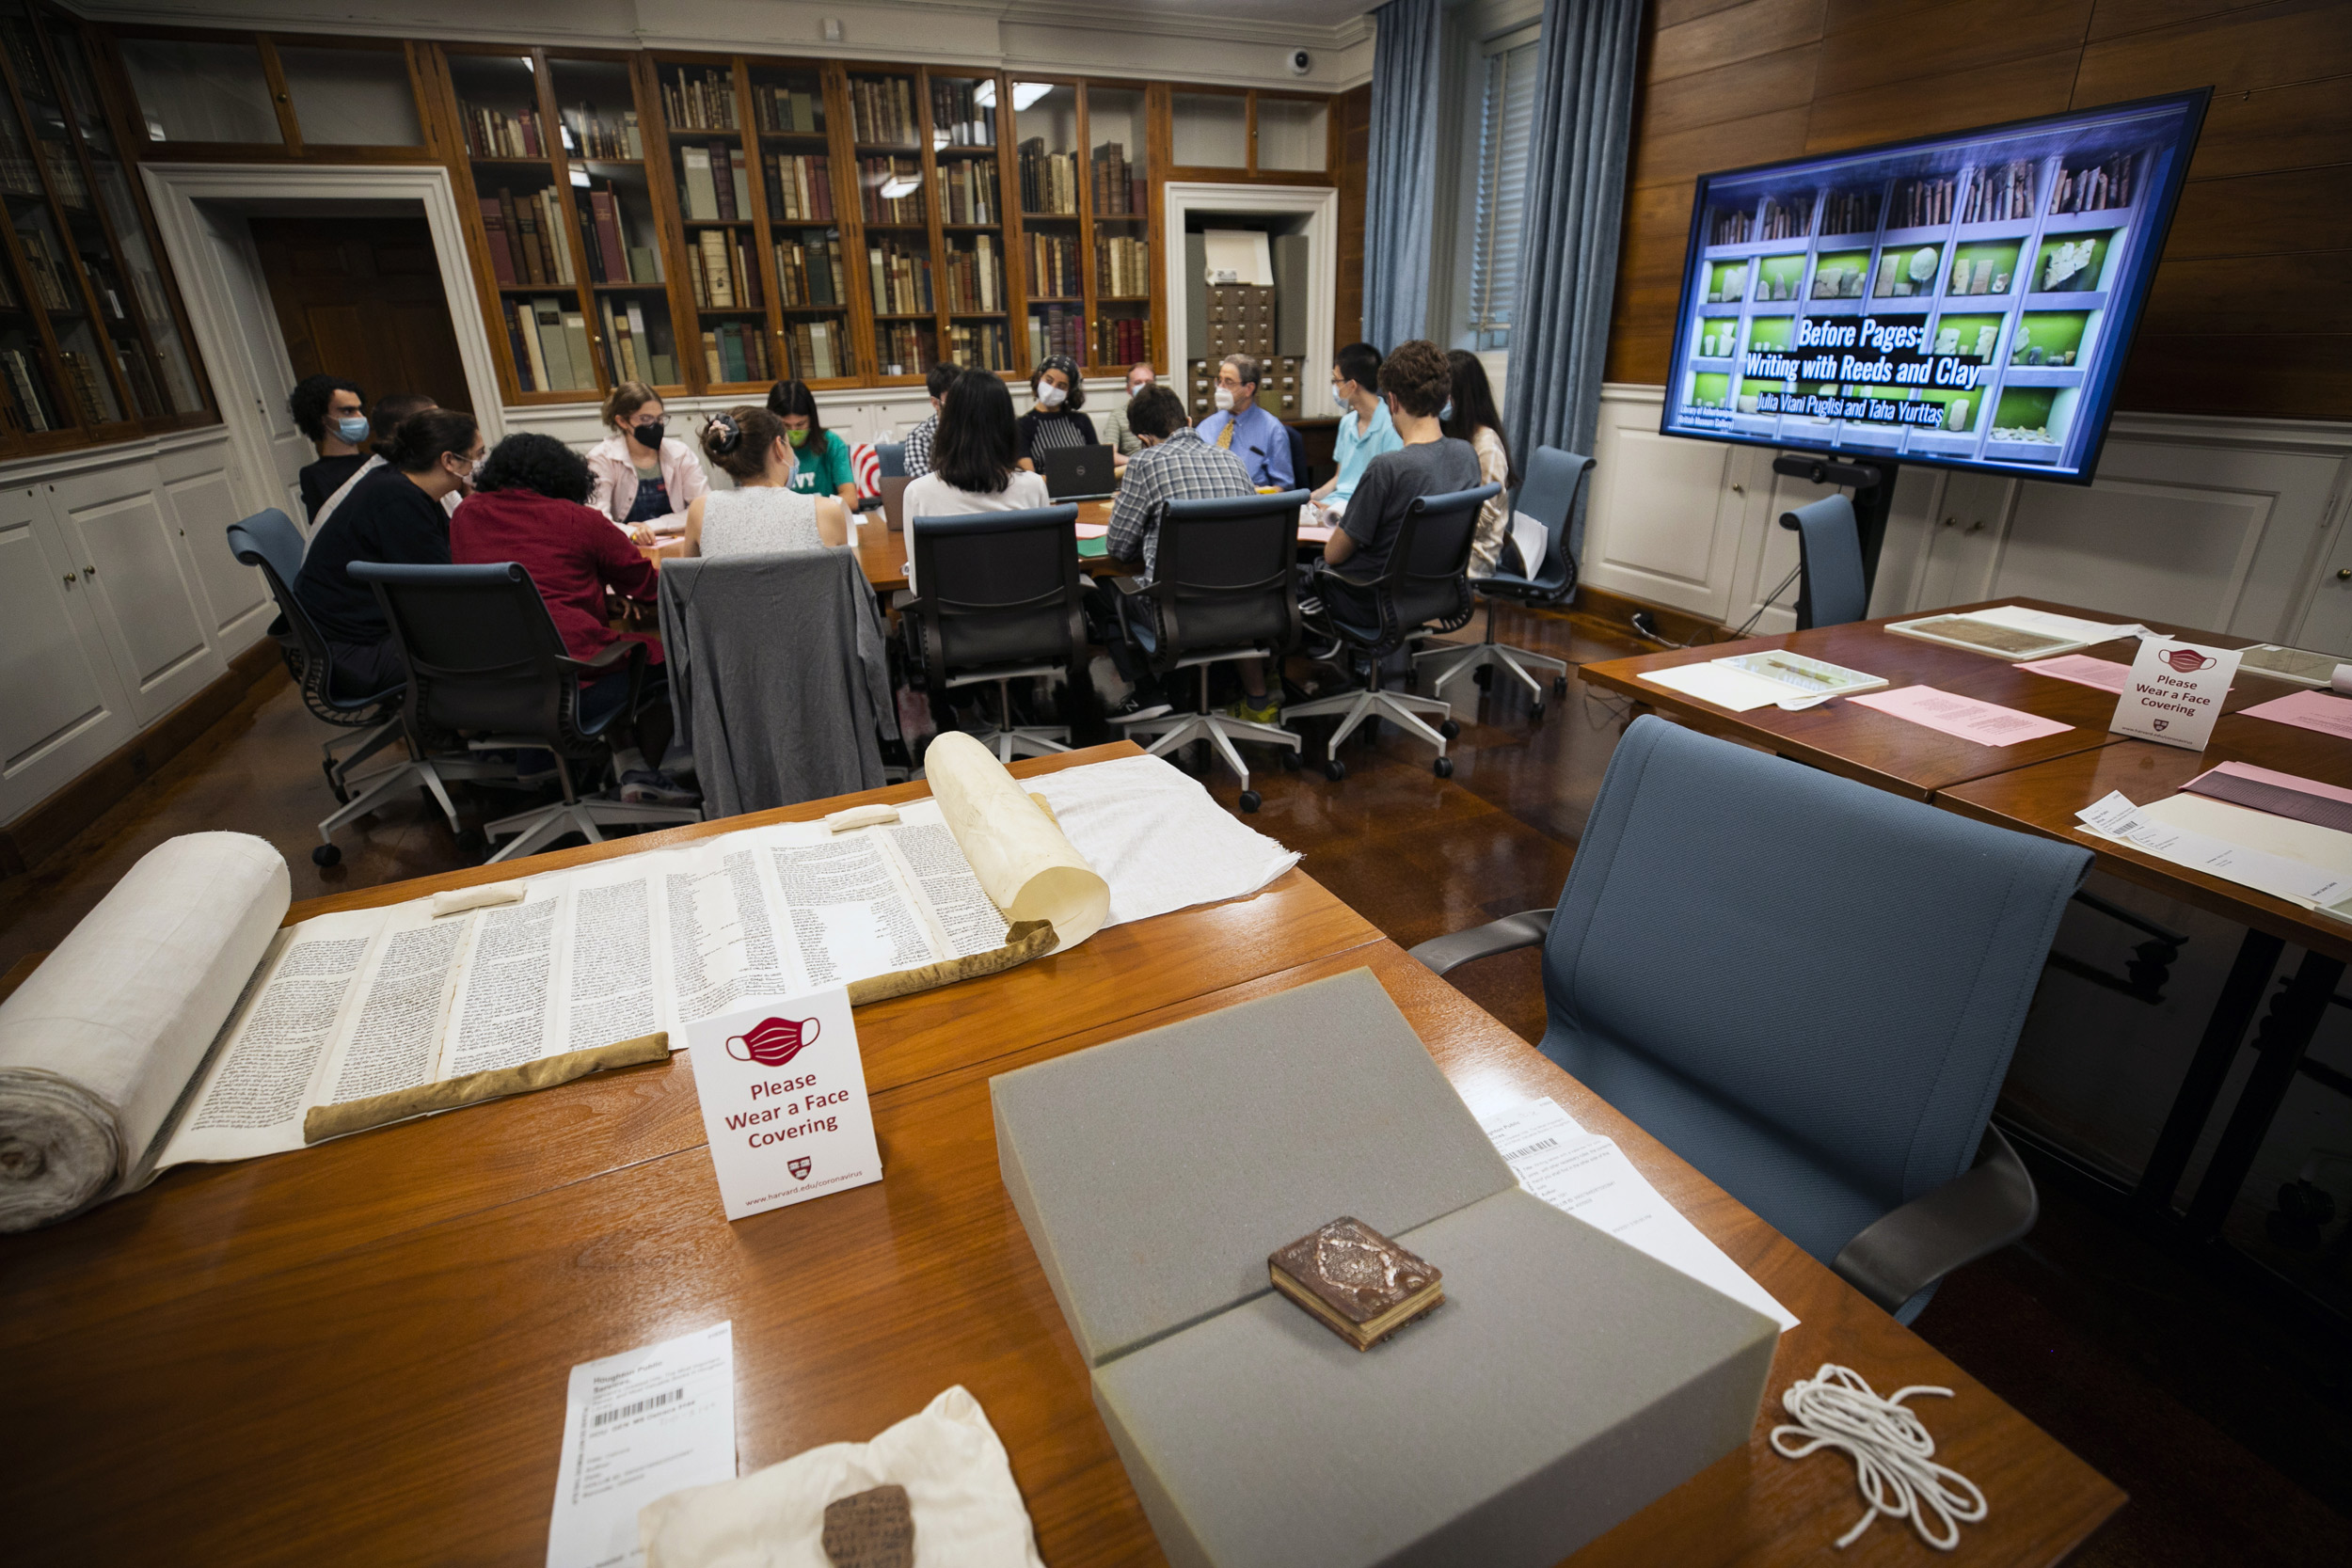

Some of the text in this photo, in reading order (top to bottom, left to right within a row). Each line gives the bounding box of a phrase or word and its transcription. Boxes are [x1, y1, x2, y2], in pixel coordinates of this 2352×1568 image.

[1798, 318, 1925, 354] Before Pages:
[1745, 352, 1982, 390] Writing with Reeds and Clay
[1756, 392, 1779, 412] Julia
[1780, 393, 1806, 414] Viani
[1805, 395, 1845, 418] Puglisi
[1845, 398, 1866, 419] and
[1867, 400, 1896, 421] Taha
[2136, 683, 2169, 697] Wear
[2182, 692, 2211, 705] Face
[2156, 674, 2198, 690] Please
[2141, 697, 2196, 718] Covering
[750, 1073, 817, 1101] Please
[724, 1089, 850, 1132] Wear a Face
[748, 1116, 838, 1148] Covering
[745, 1169, 863, 1207] www.harvard.edu/coronavirus
